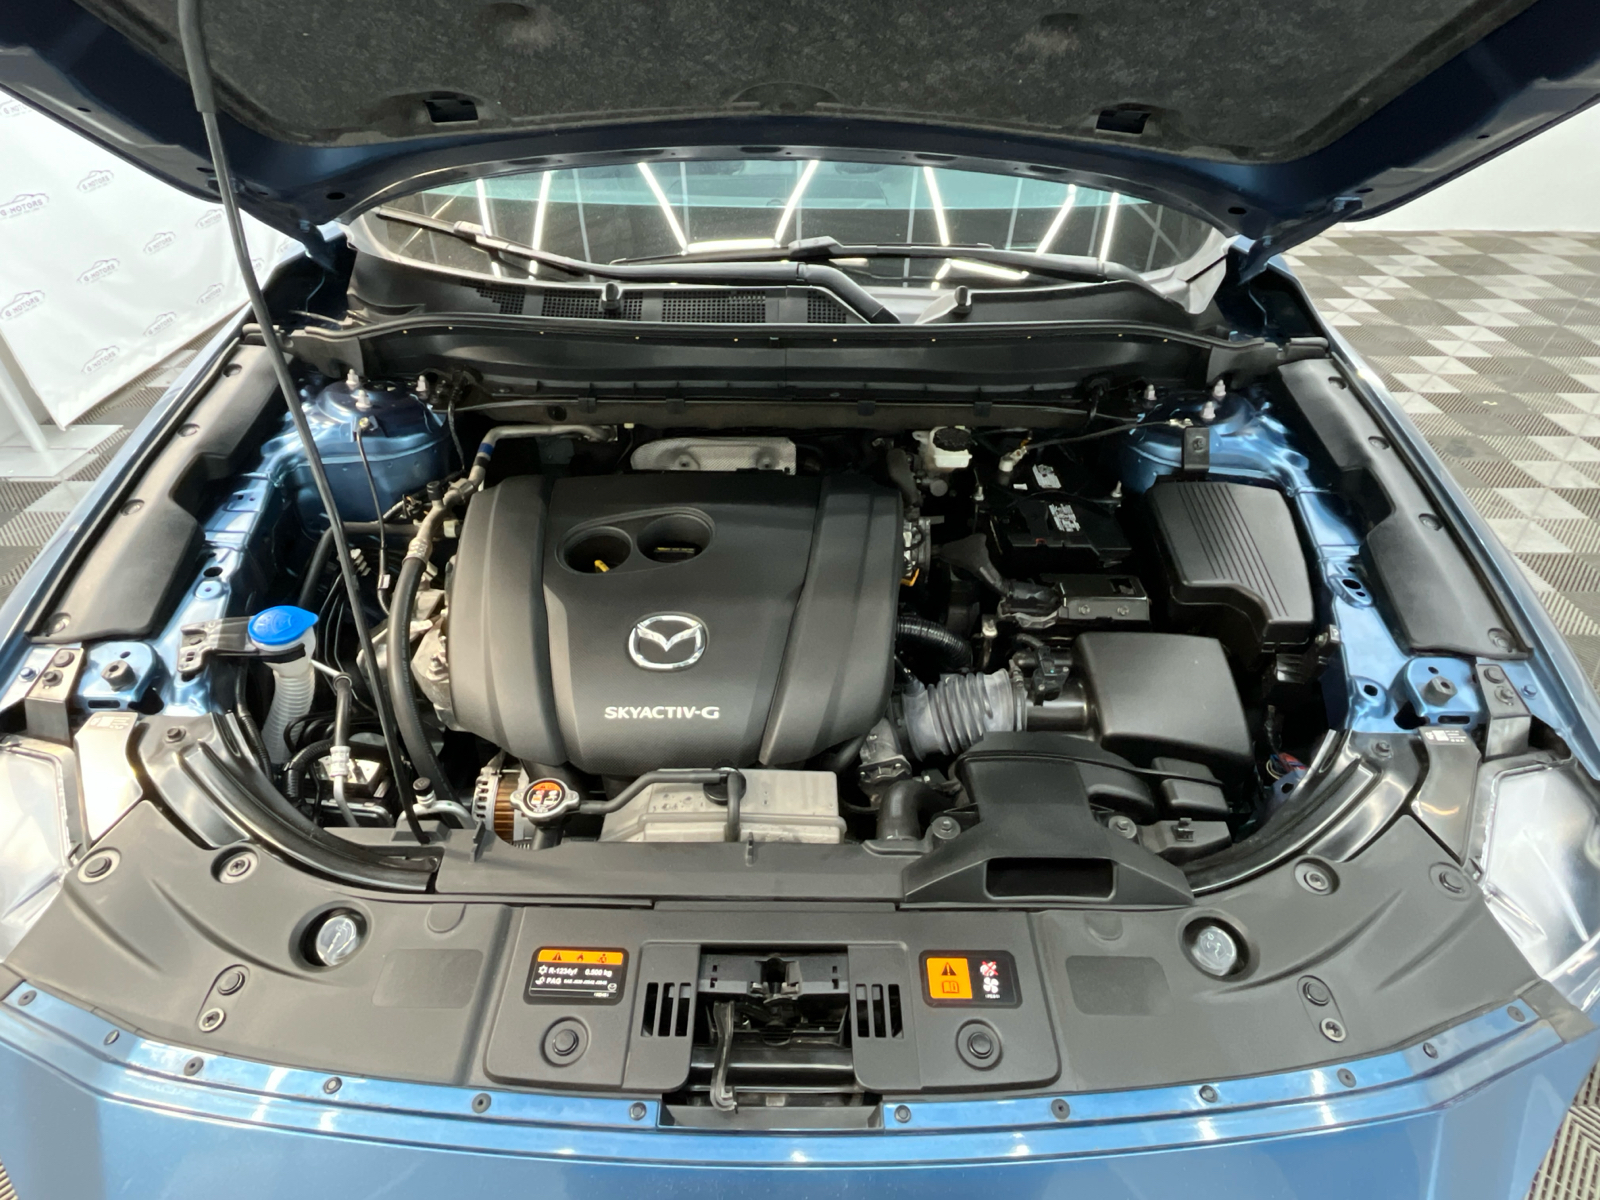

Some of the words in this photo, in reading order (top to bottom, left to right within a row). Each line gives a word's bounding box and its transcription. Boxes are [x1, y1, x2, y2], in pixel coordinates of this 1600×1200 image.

[604, 706, 720, 719] SKYACTIV-G
[603, 969, 613, 978] kg
[546, 977, 562, 985] PAG
